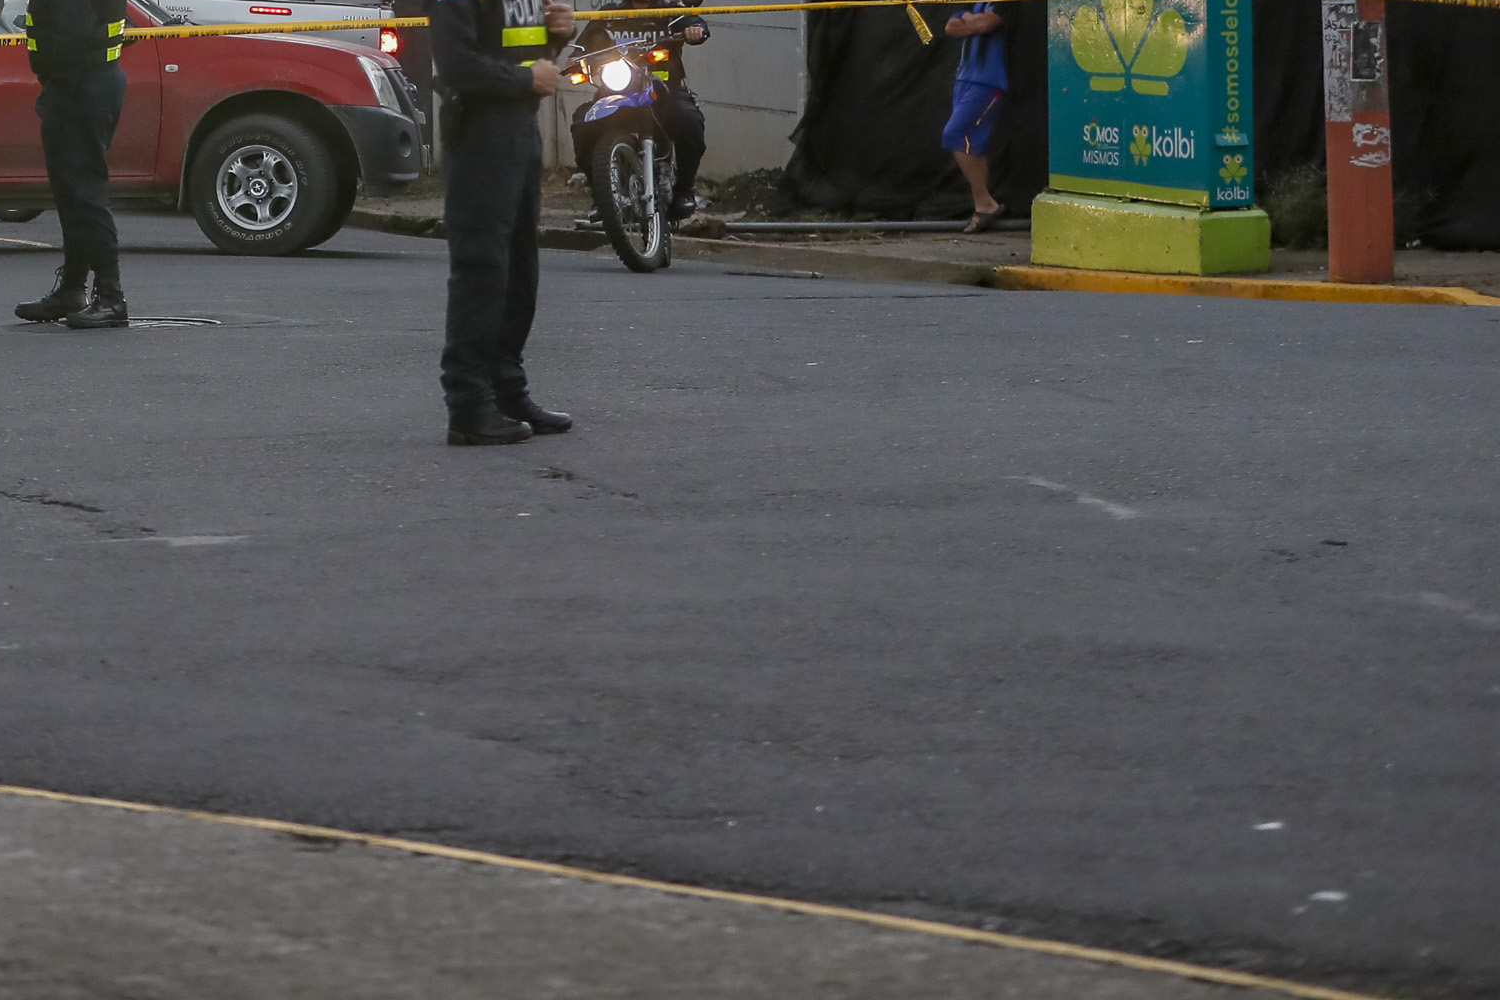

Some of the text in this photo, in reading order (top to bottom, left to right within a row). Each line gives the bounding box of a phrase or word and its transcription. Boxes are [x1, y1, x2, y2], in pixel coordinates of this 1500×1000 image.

[1083, 122, 1119, 146] SOMOS
[1152, 125, 1196, 159] kölbi
[1083, 149, 1119, 166] MISMOS
[1217, 186, 1250, 201] kölbi
